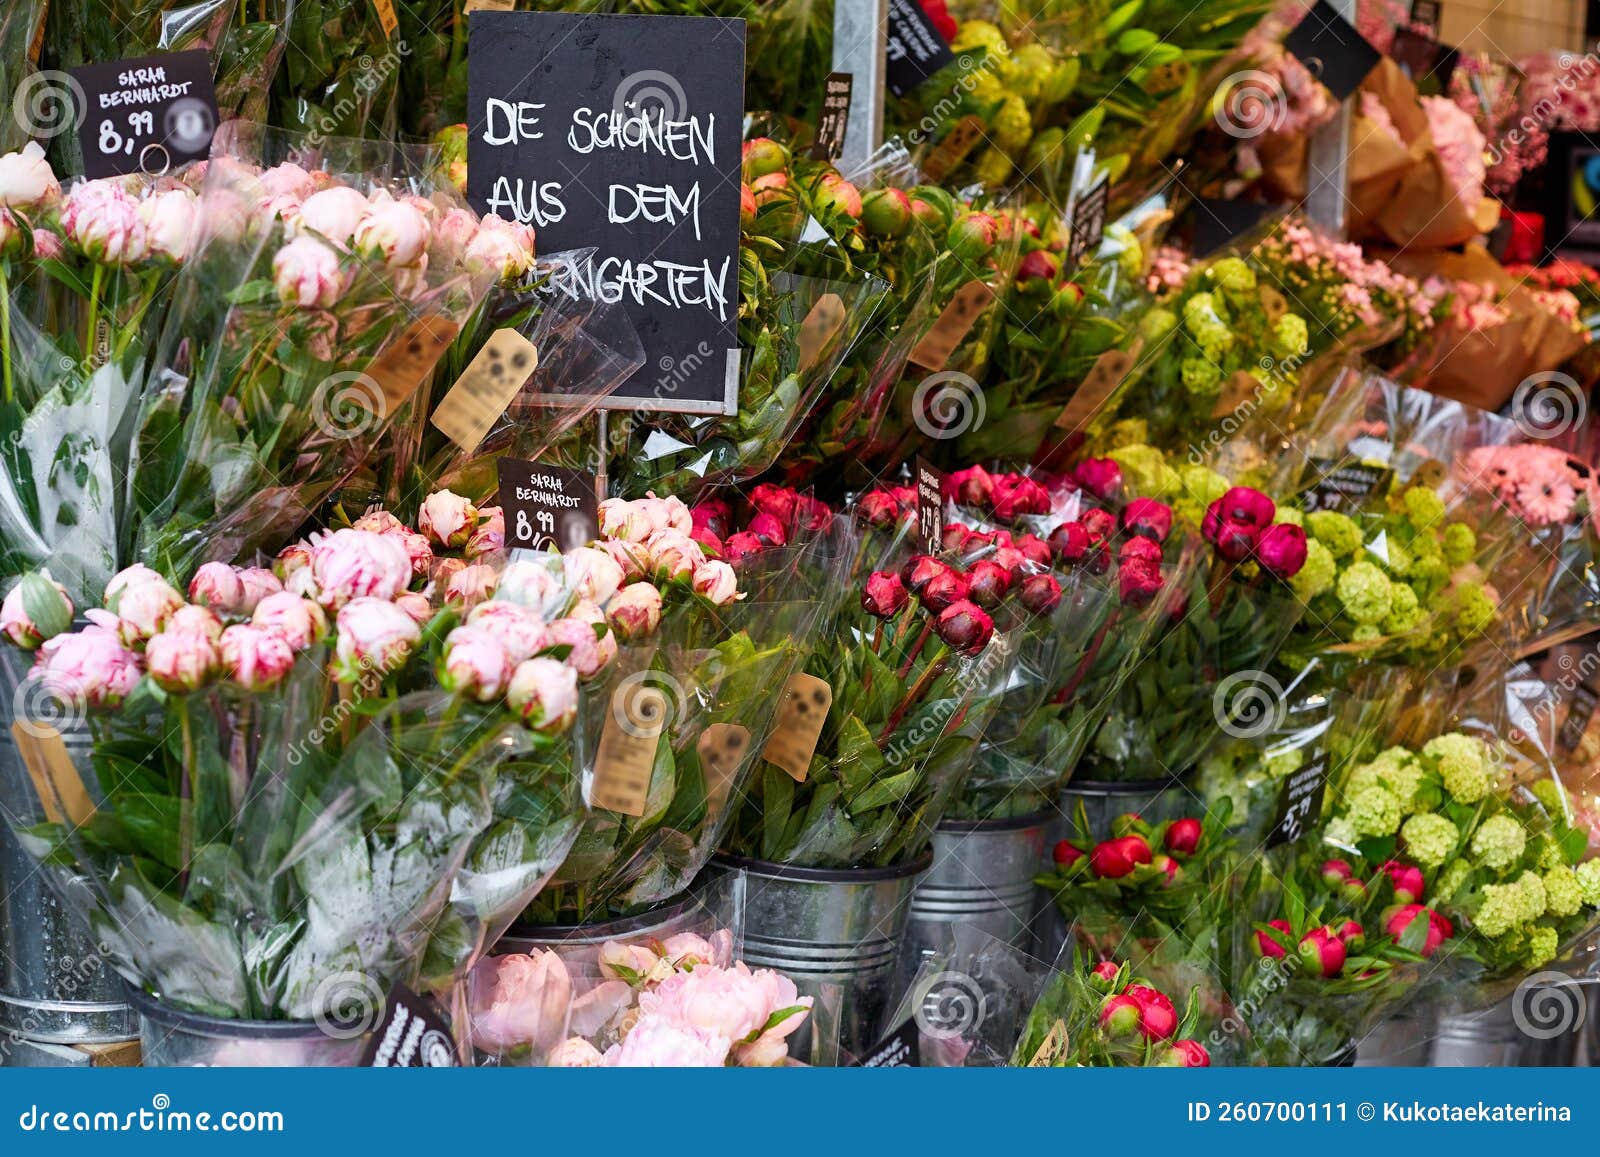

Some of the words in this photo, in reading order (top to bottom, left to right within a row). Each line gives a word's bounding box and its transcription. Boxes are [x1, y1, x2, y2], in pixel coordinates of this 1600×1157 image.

[99, 81, 193, 109] BERNHARDT
[118, 66, 166, 87] SARAH
[98, 110, 154, 155] 8,99
[483, 97, 546, 146] DIE
[567, 101, 715, 166] SCHÖNEN
[486, 176, 567, 227] AUS
[608, 181, 701, 241] DEM
[525, 255, 731, 322] ERNGARTEN
[515, 486, 581, 508] BERNHARDT
[530, 473, 563, 492] SARAH
[515, 509, 554, 547] 8,99
